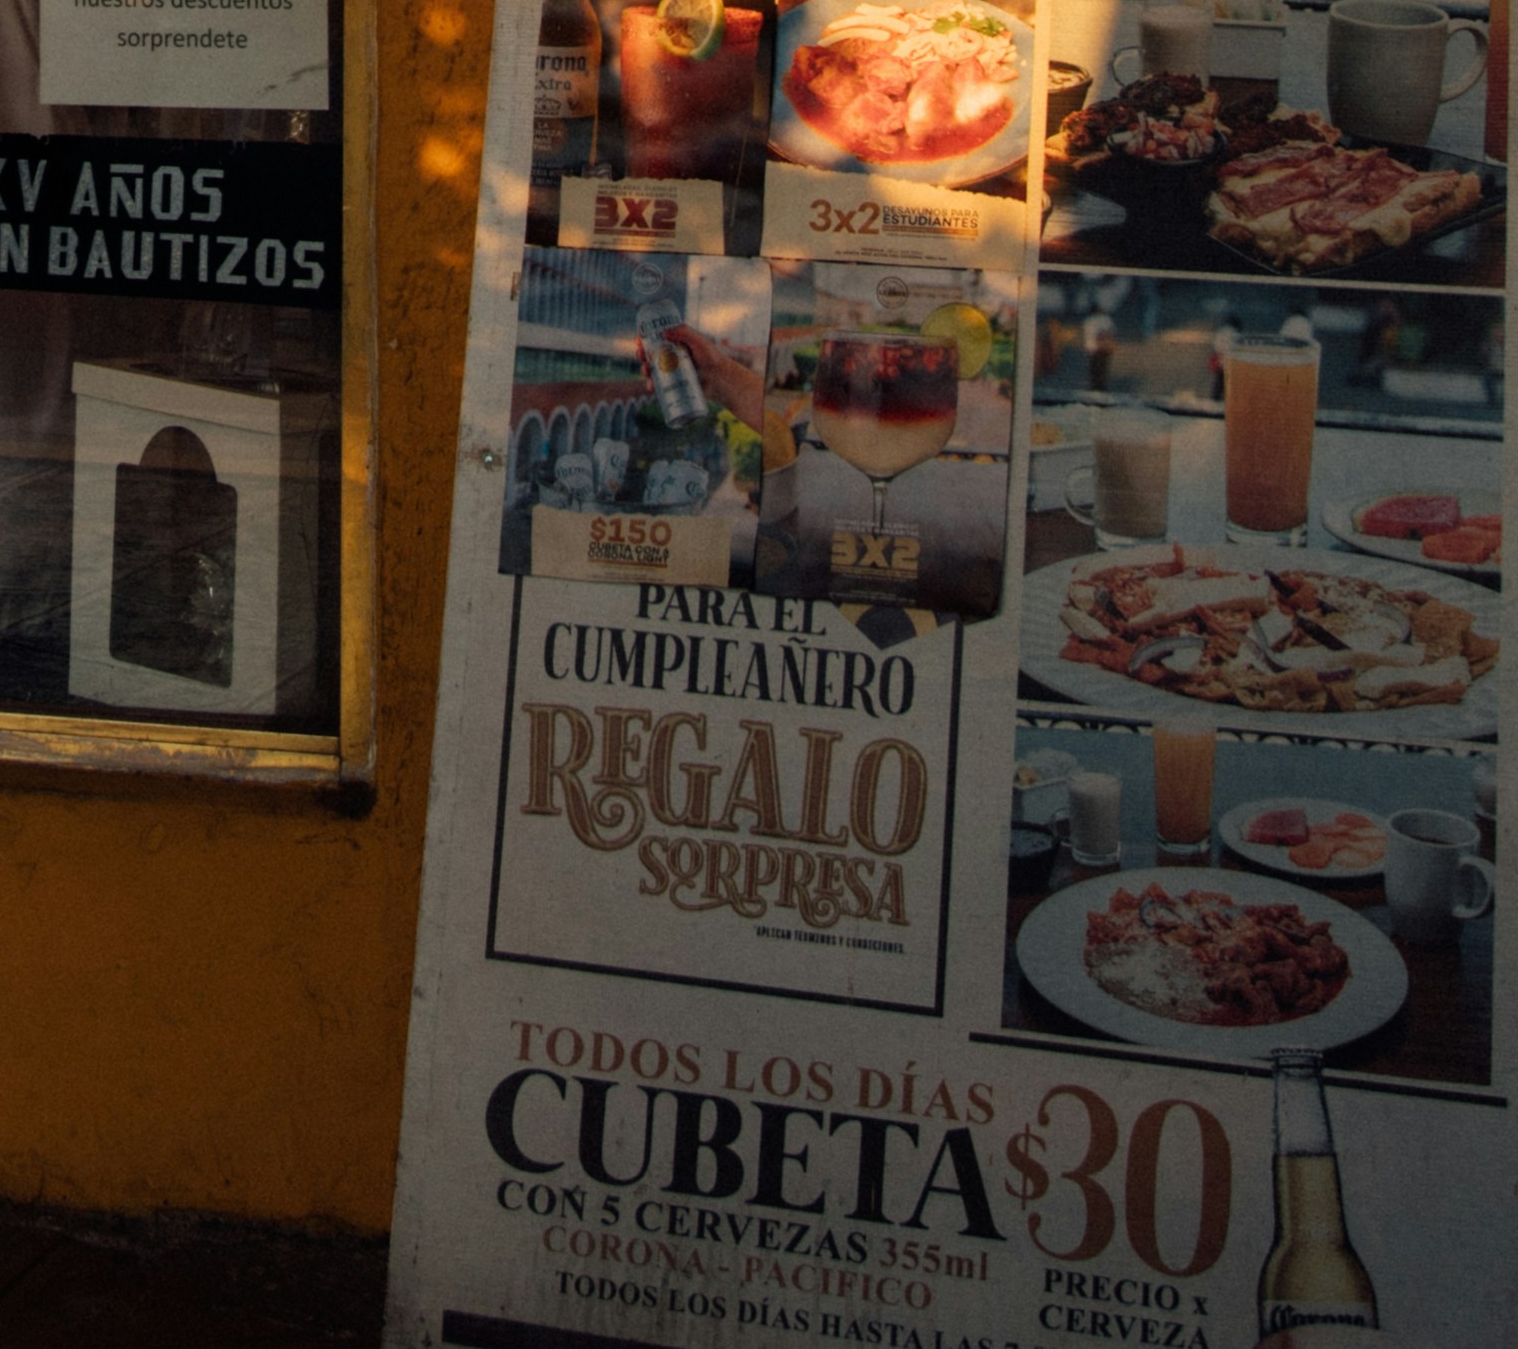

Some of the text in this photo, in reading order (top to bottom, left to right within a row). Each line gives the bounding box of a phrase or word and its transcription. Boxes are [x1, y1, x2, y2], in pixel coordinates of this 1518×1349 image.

[117, 27, 249, 52] sorprendete
[69, 160, 225, 223] AÑOS
[593, 195, 679, 230] 3X2
[808, 198, 881, 235] 3x2
[882, 204, 980, 219] DESAYUNOS PARA
[882, 214, 979, 230] ESTUDIANTES
[46, 223, 326, 290] BAUTIZOS
[589, 516, 673, 546] $150
[829, 529, 921, 570] 3X2
[635, 583, 827, 636] PARA EL
[543, 622, 916, 719] CUMPLEAÑERO
[520, 702, 929, 857] REGALO
[638, 834, 912, 929] SORPRESA
[509, 1019, 996, 1126] TODOS LOS DÍAS
[485, 1067, 1007, 1241] CUBETA
[1003, 1084, 1233, 1278] $30
[496, 1179, 989, 1281] CON 5 CERVEZAS 355ml
[541, 1224, 706, 1277] CORONA
[742, 1254, 934, 1310] PACIFICO
[1043, 1268, 1209, 1316] PRECIO x
[554, 1270, 658, 1309] TODOS
[668, 1288, 727, 1321] LOS
[737, 1295, 811, 1333] DÍAS
[820, 1315, 924, 1349] HASTA
[1038, 1303, 1211, 1349] CERVEZA
